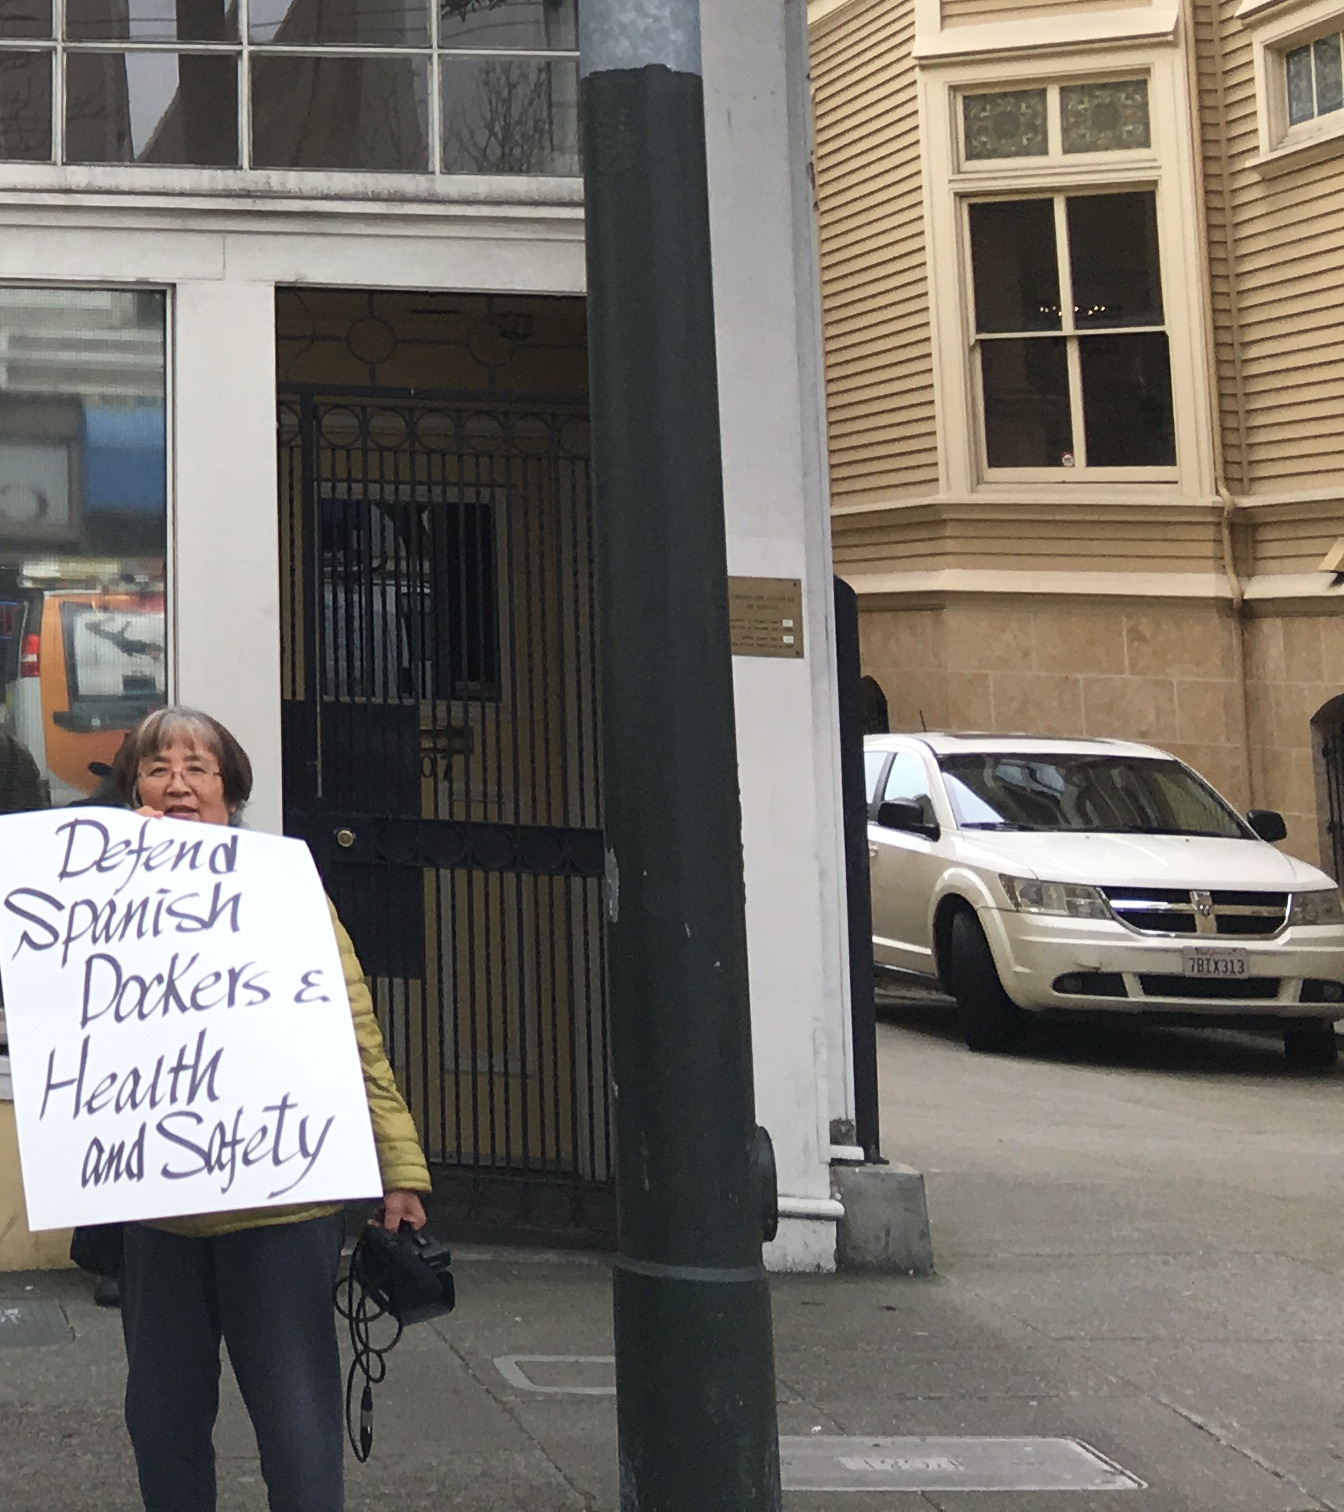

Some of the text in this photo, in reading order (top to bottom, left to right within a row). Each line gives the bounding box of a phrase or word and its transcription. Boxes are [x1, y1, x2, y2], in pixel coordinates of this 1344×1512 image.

[55, 817, 239, 896] Defend
[3, 881, 242, 968] Spanish
[80, 952, 271, 1029] Dockers
[39, 1027, 224, 1120] Health
[81, 1092, 336, 1199] and Safety
